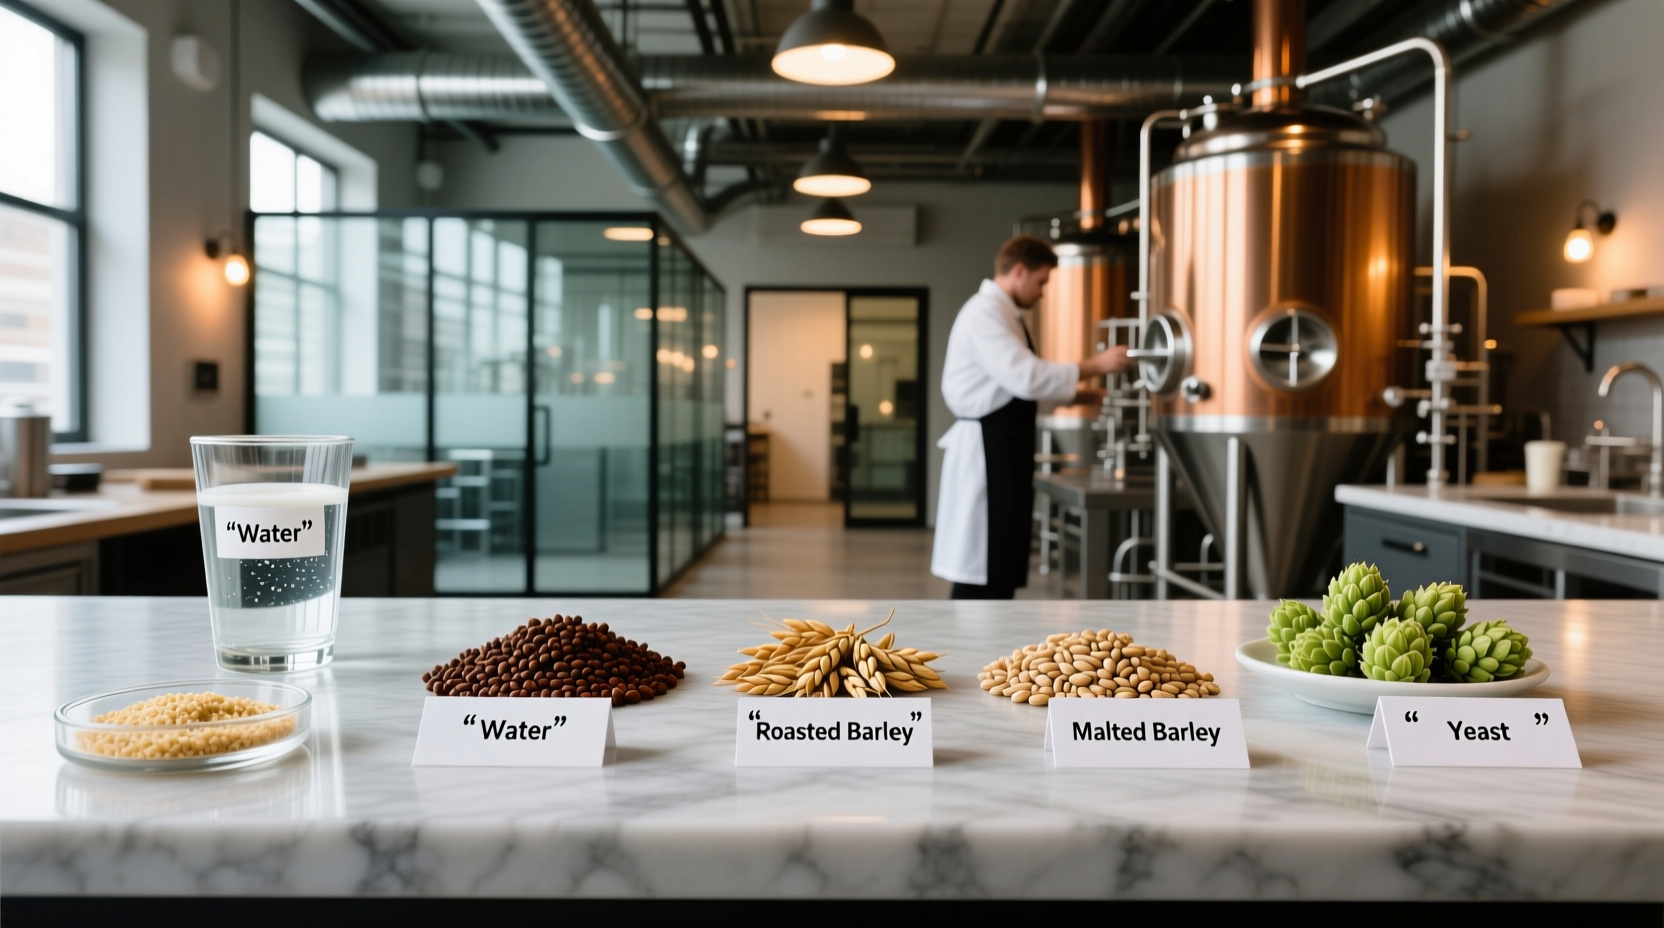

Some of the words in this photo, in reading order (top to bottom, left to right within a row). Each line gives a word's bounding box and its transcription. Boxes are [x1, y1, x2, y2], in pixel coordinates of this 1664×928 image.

[226, 519, 313, 544] “Water”
[463, 713, 567, 741] “Water”
[748, 709, 841, 741] “Roasted
[847, 709, 923, 747] Barley”
[1072, 721, 1147, 742] Malted
[1152, 721, 1221, 748] Barley
